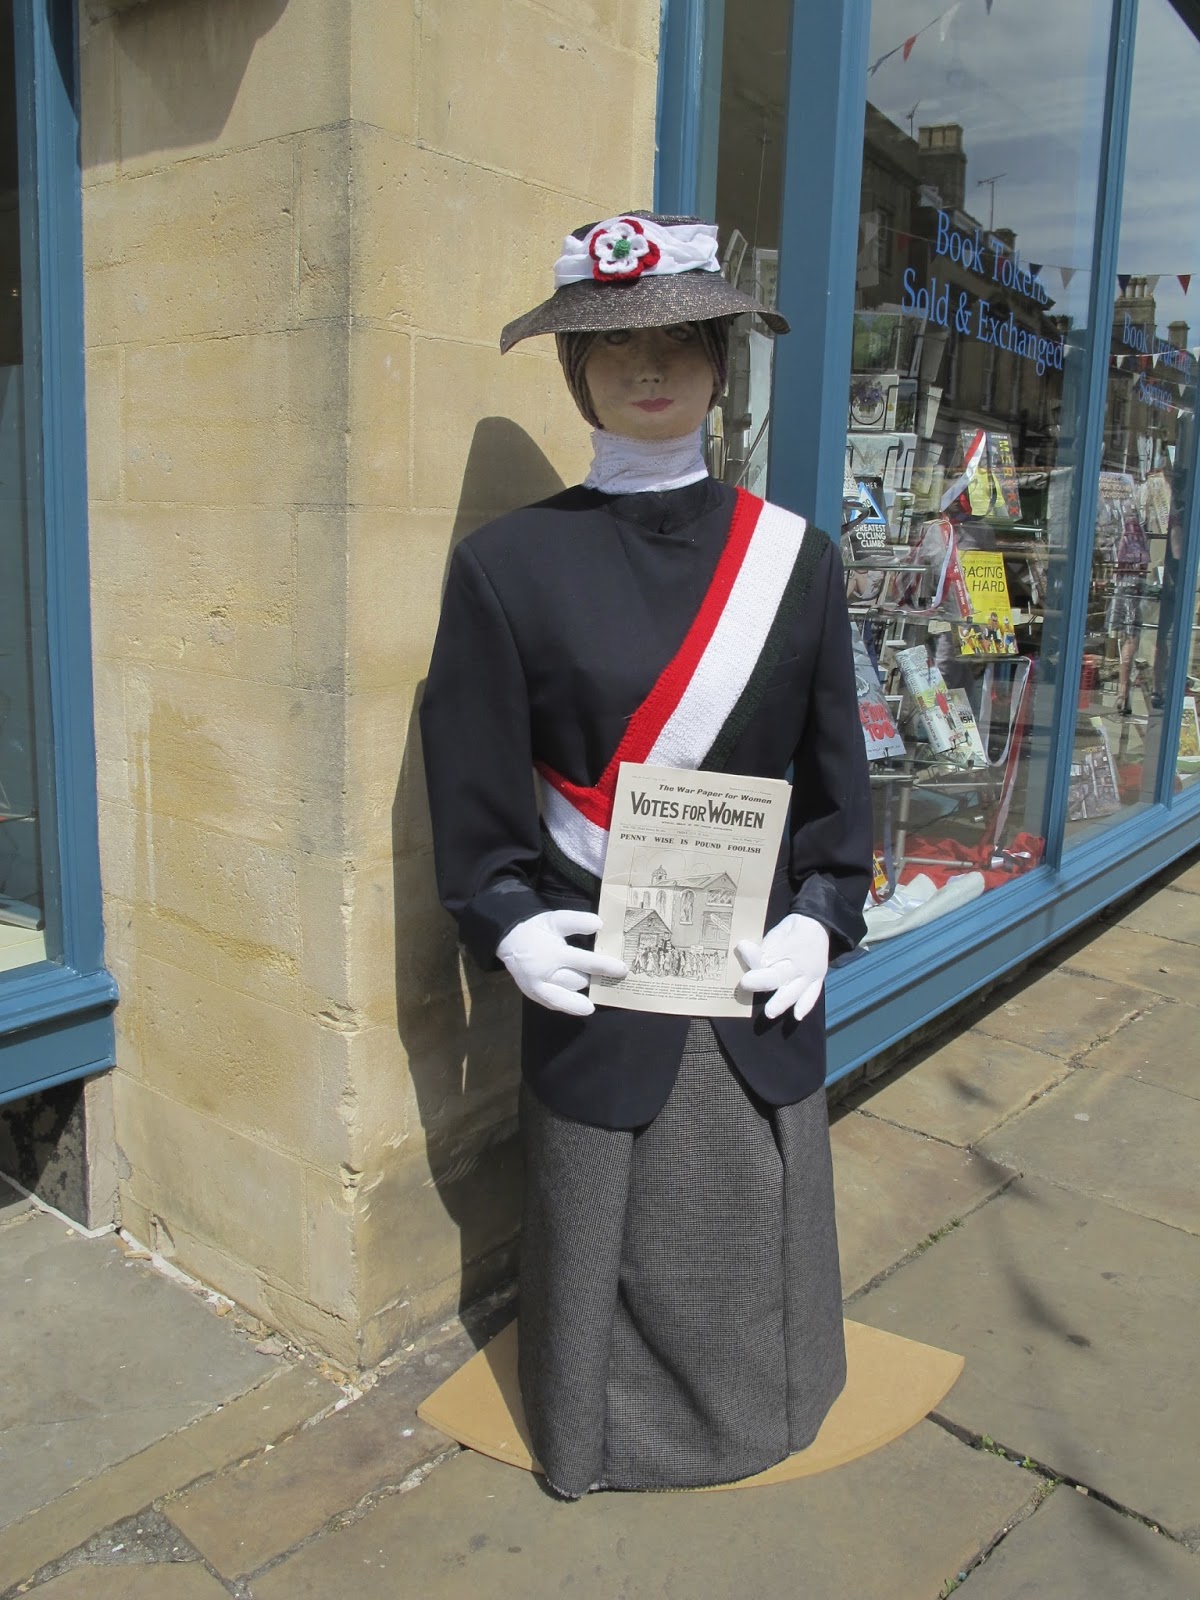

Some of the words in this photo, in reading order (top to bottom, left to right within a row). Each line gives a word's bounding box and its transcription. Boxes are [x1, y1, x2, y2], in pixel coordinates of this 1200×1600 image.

[935, 208, 985, 275] Book
[989, 240, 1048, 304] Tokens
[901, 267, 950, 327] Sold
[955, 291, 971, 336] &
[976, 299, 1065, 376] Exchanged
[1123, 313, 1149, 353] Book
[1151, 328, 1192, 385] Ordering
[856, 532, 887, 540] CYCLING
[861, 539, 886, 548] CLIMBS
[972, 580, 1006, 593] HARD
[865, 721, 895, 741] TOO
[658, 784, 674, 792] The
[677, 786, 695, 794] War
[697, 788, 723, 798] Paper
[725, 792, 738, 800] for
[741, 795, 773, 804] Women
[630, 791, 679, 819] VOTES
[681, 804, 707, 822] FOR
[708, 799, 766, 829] WOMEN
[620, 833, 647, 842] PENNY
[654, 836, 674, 844] WISE
[695, 840, 721, 849] POUND
[727, 844, 762, 854] FOOLISH
